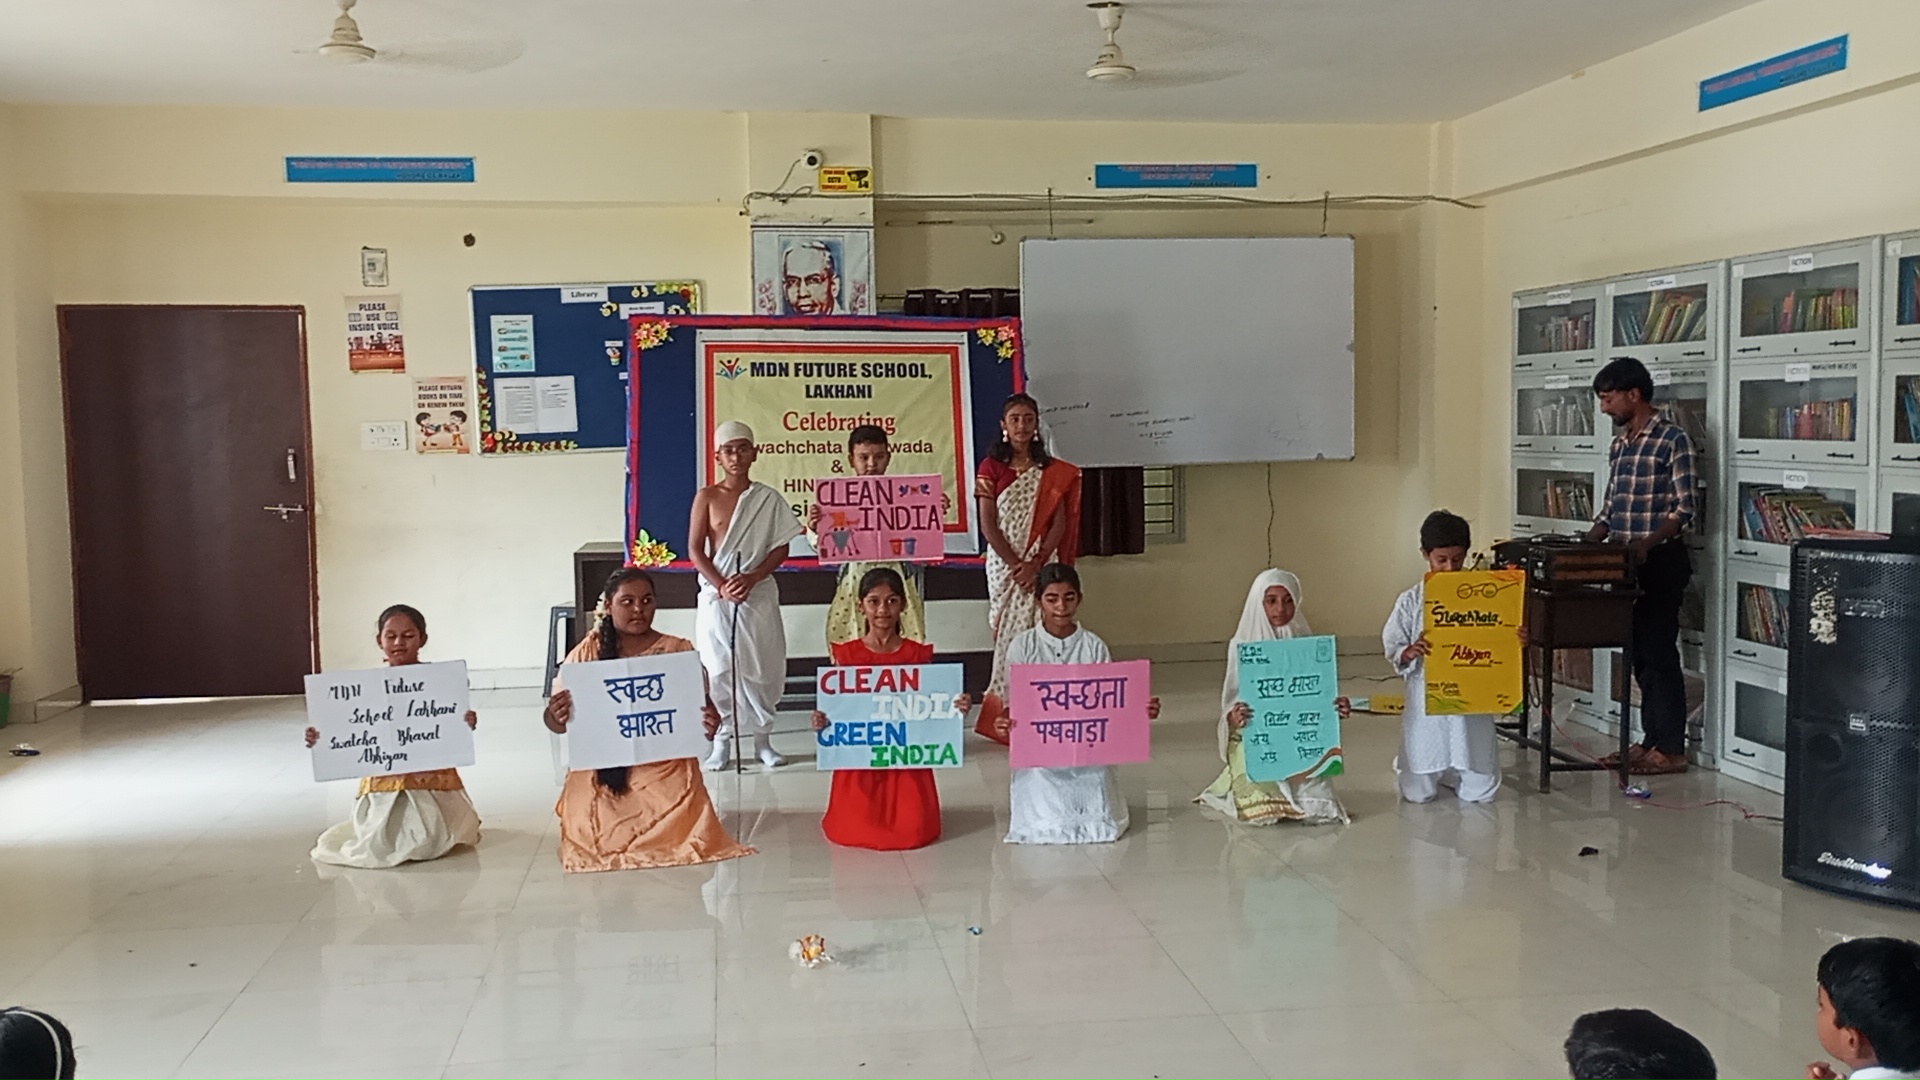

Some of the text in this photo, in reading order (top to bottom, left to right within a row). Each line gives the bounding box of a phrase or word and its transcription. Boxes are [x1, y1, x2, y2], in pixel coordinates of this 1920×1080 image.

[359, 303, 386, 311] PLEASE
[366, 313, 380, 321] USE
[349, 322, 399, 331] INSIDE VOICE
[750, 362, 933, 379] MDN FUTURE SCHOOL,
[805, 384, 873, 399] LAKHANI
[783, 411, 896, 435] Celebrating
[755, 440, 843, 454] wachchata
[831, 460, 844, 473] &
[817, 480, 894, 506] CLEAN
[859, 505, 940, 531] INDIA
[384, 677, 425, 695] Future
[604, 673, 666, 703] स्वच्छ
[820, 668, 919, 695] CLEAN
[1030, 677, 1128, 711] स्वच्छता
[348, 699, 458, 725] School Lakhani
[617, 709, 677, 738] भारत
[397, 724, 441, 746] Bharat
[817, 721, 907, 747] GREEN
[357, 746, 408, 771] Abhiyan
[870, 743, 958, 767] INDIA
